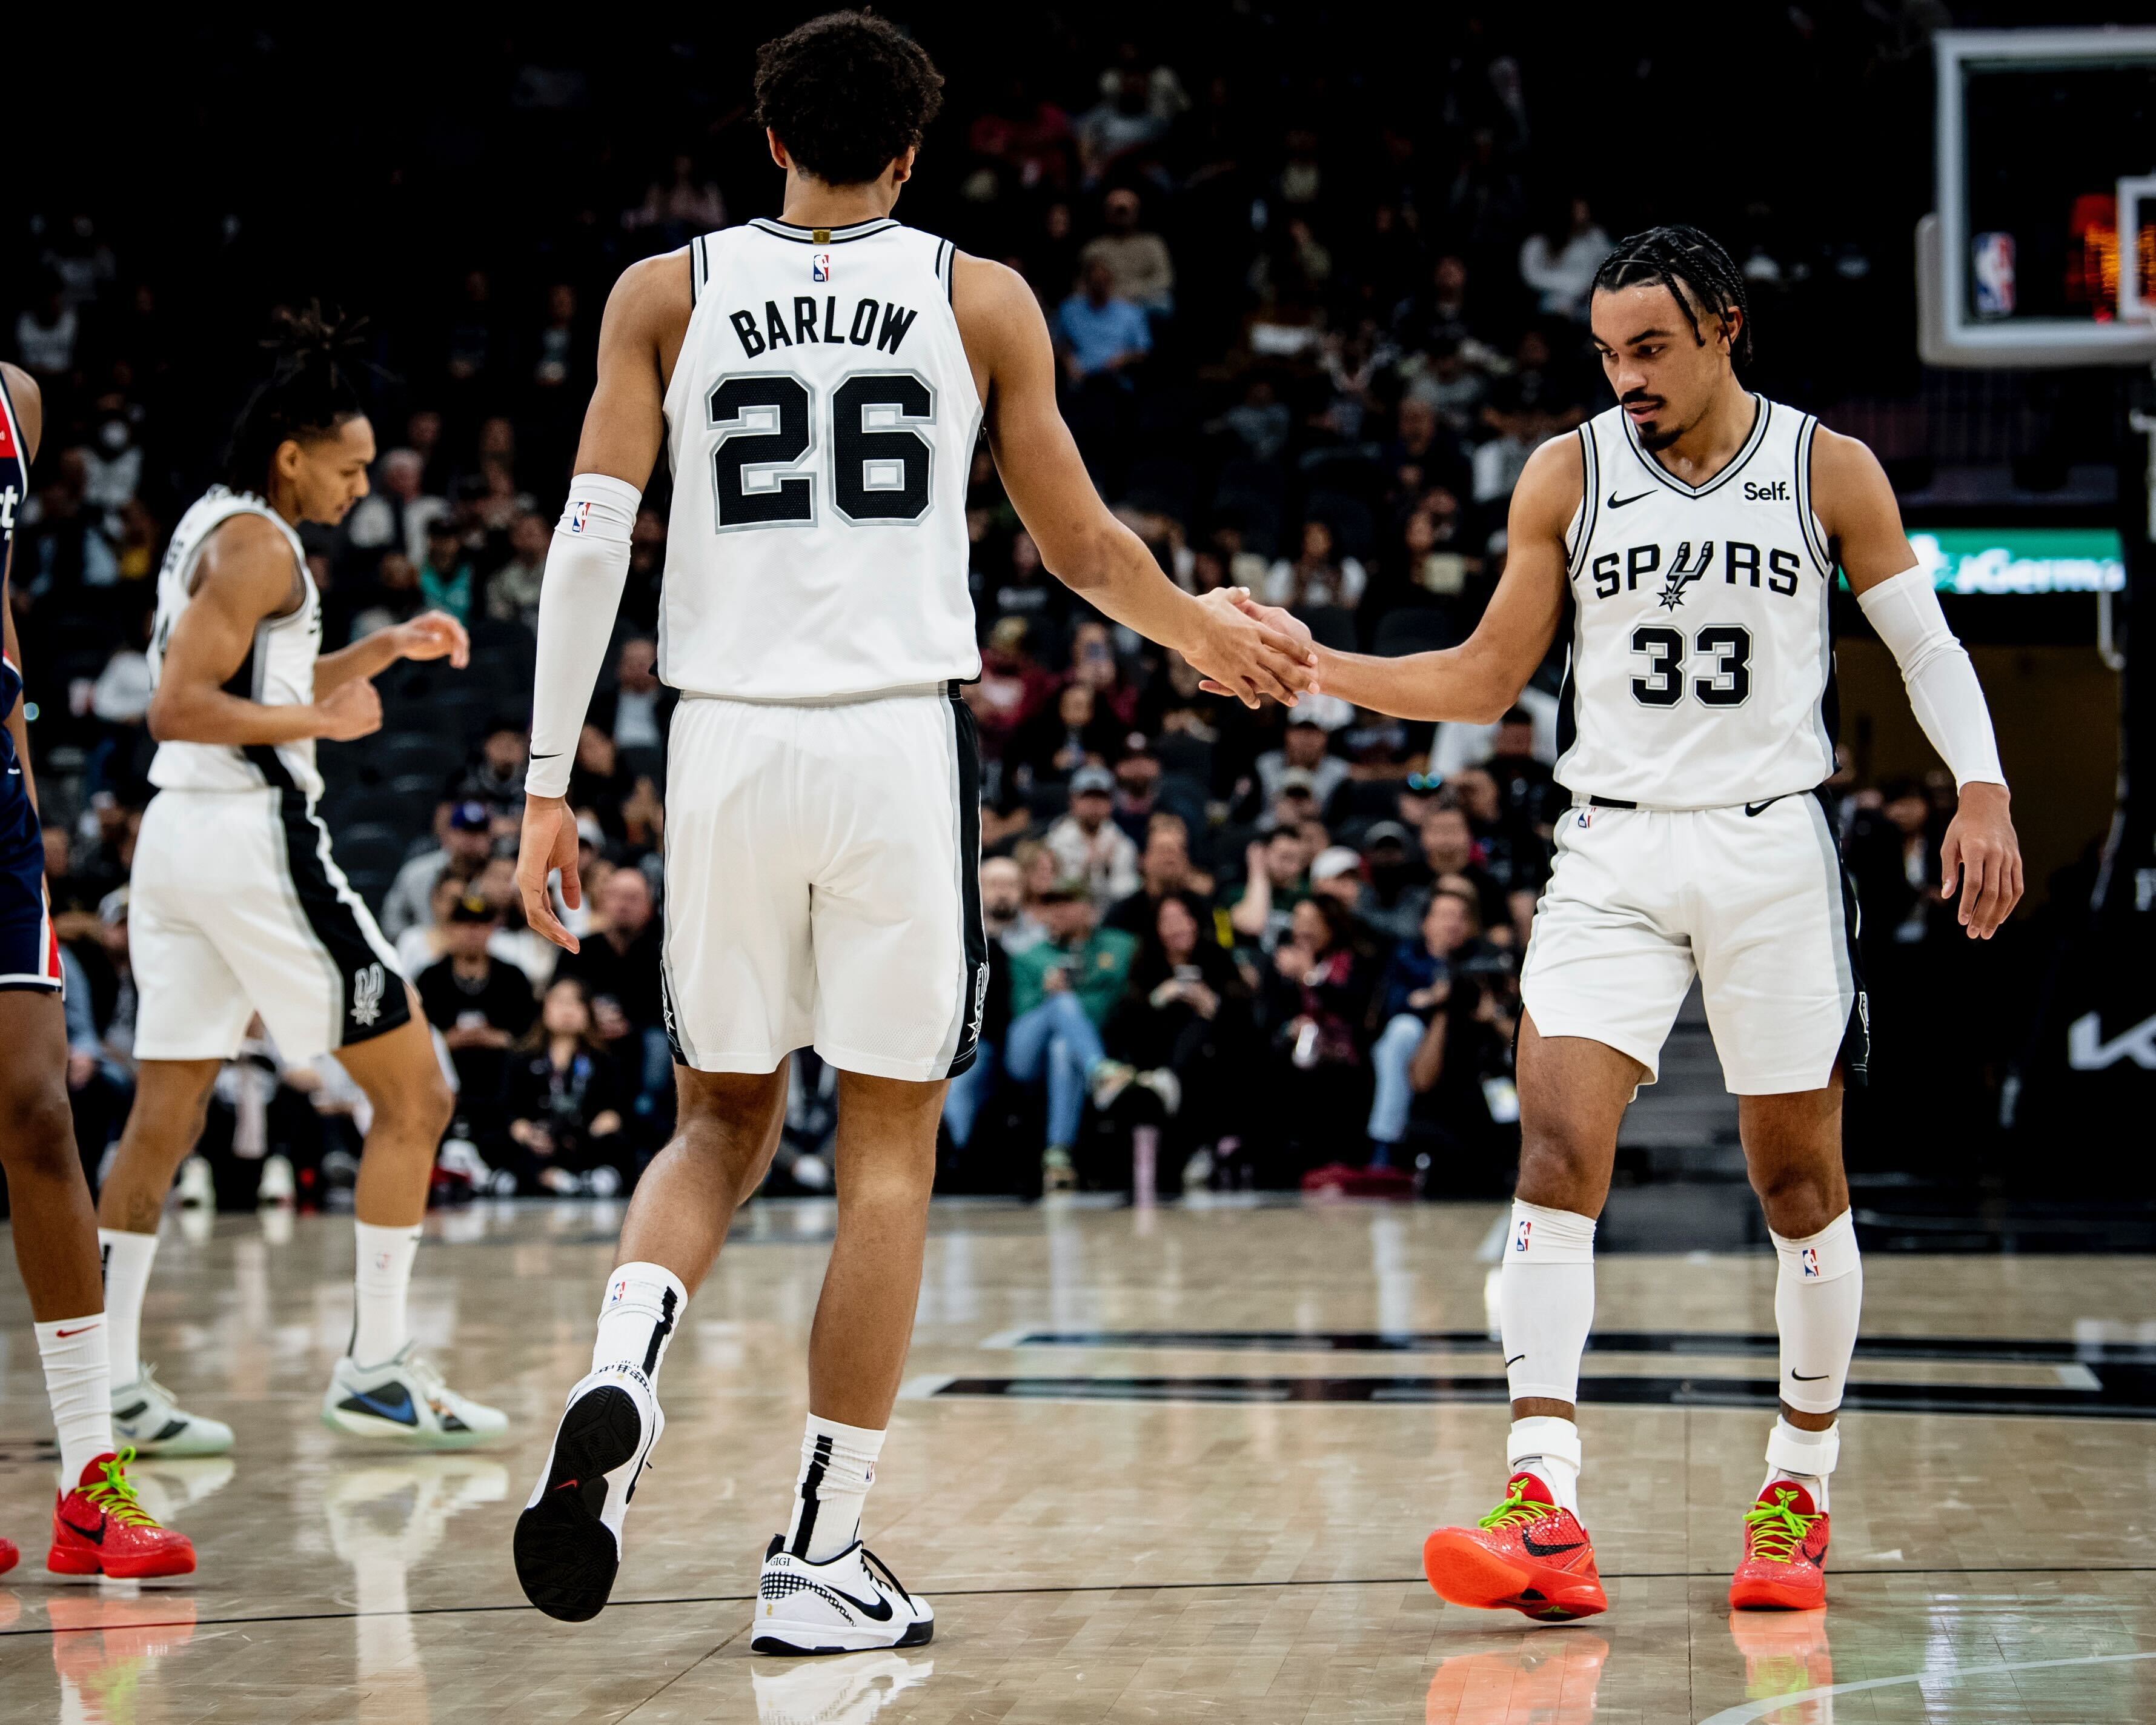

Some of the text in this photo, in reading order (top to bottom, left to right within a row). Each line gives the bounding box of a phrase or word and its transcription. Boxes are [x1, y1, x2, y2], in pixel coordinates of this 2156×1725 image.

[729, 296, 918, 359] BARLOW
[705, 368, 937, 534] 26
[1744, 482, 1790, 501] Self.
[1592, 540, 1800, 612] SPURS
[1630, 623, 1754, 709] 33
[771, 1557, 791, 1566] GIGI
